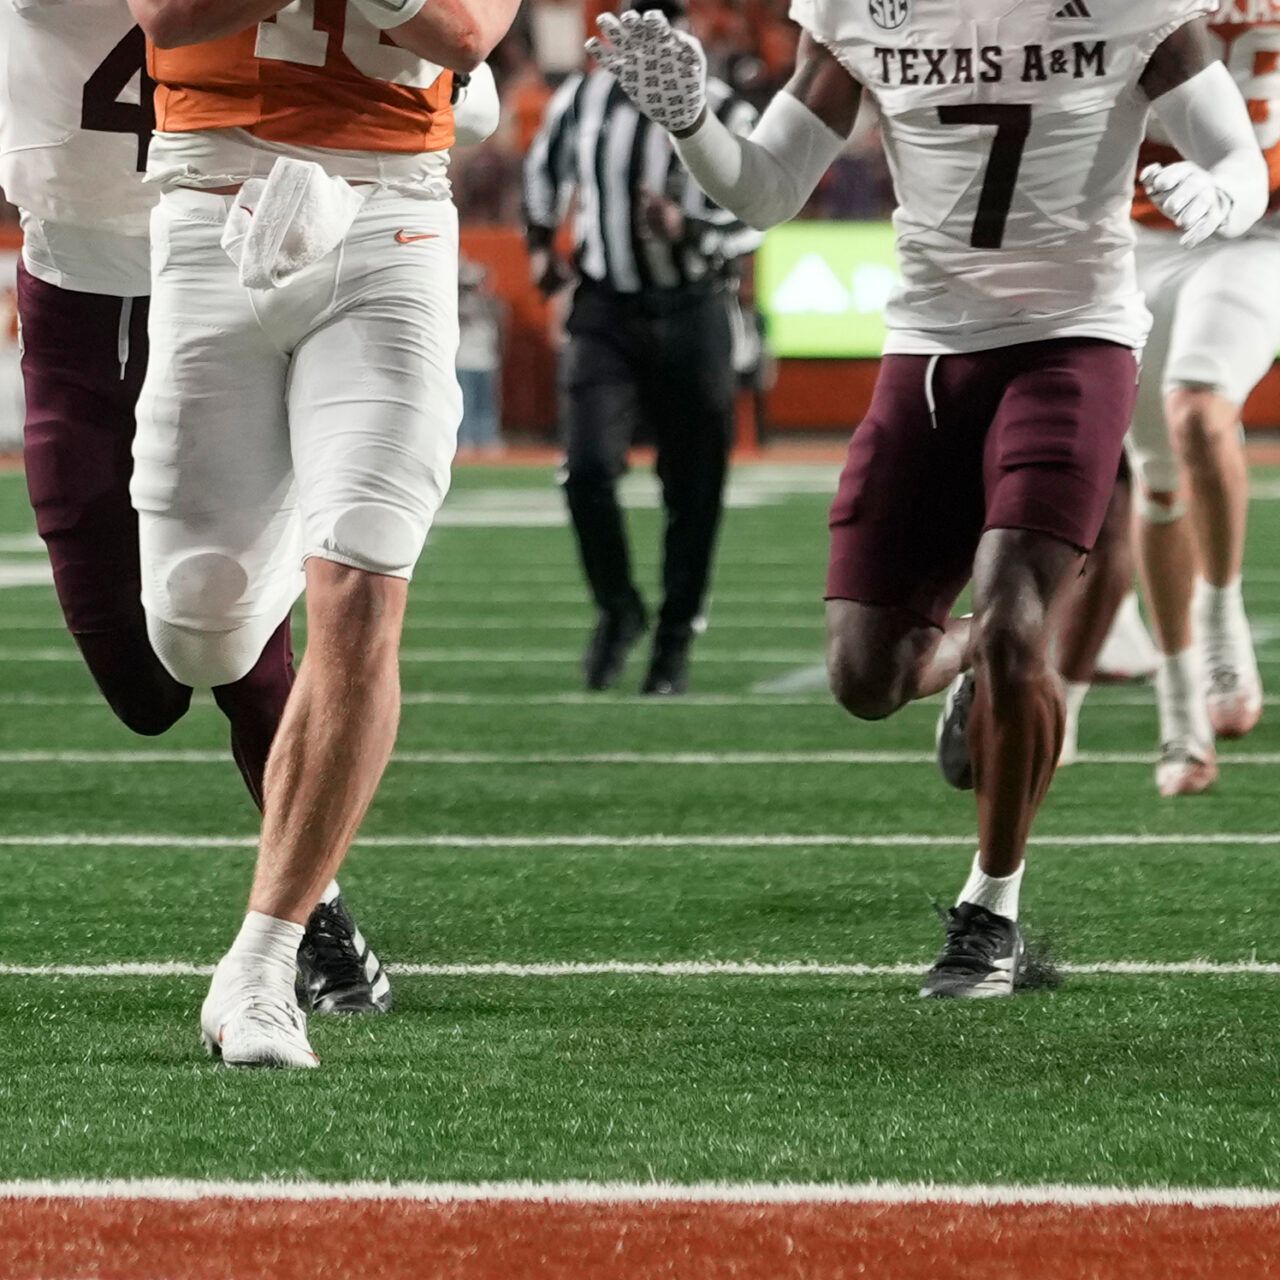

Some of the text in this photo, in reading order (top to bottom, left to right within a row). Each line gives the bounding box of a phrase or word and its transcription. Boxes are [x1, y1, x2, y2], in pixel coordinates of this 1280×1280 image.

[81, 23, 157, 173] 4
[874, 40, 1106, 85] TEXAS A&M
[937, 104, 1031, 249] 7
